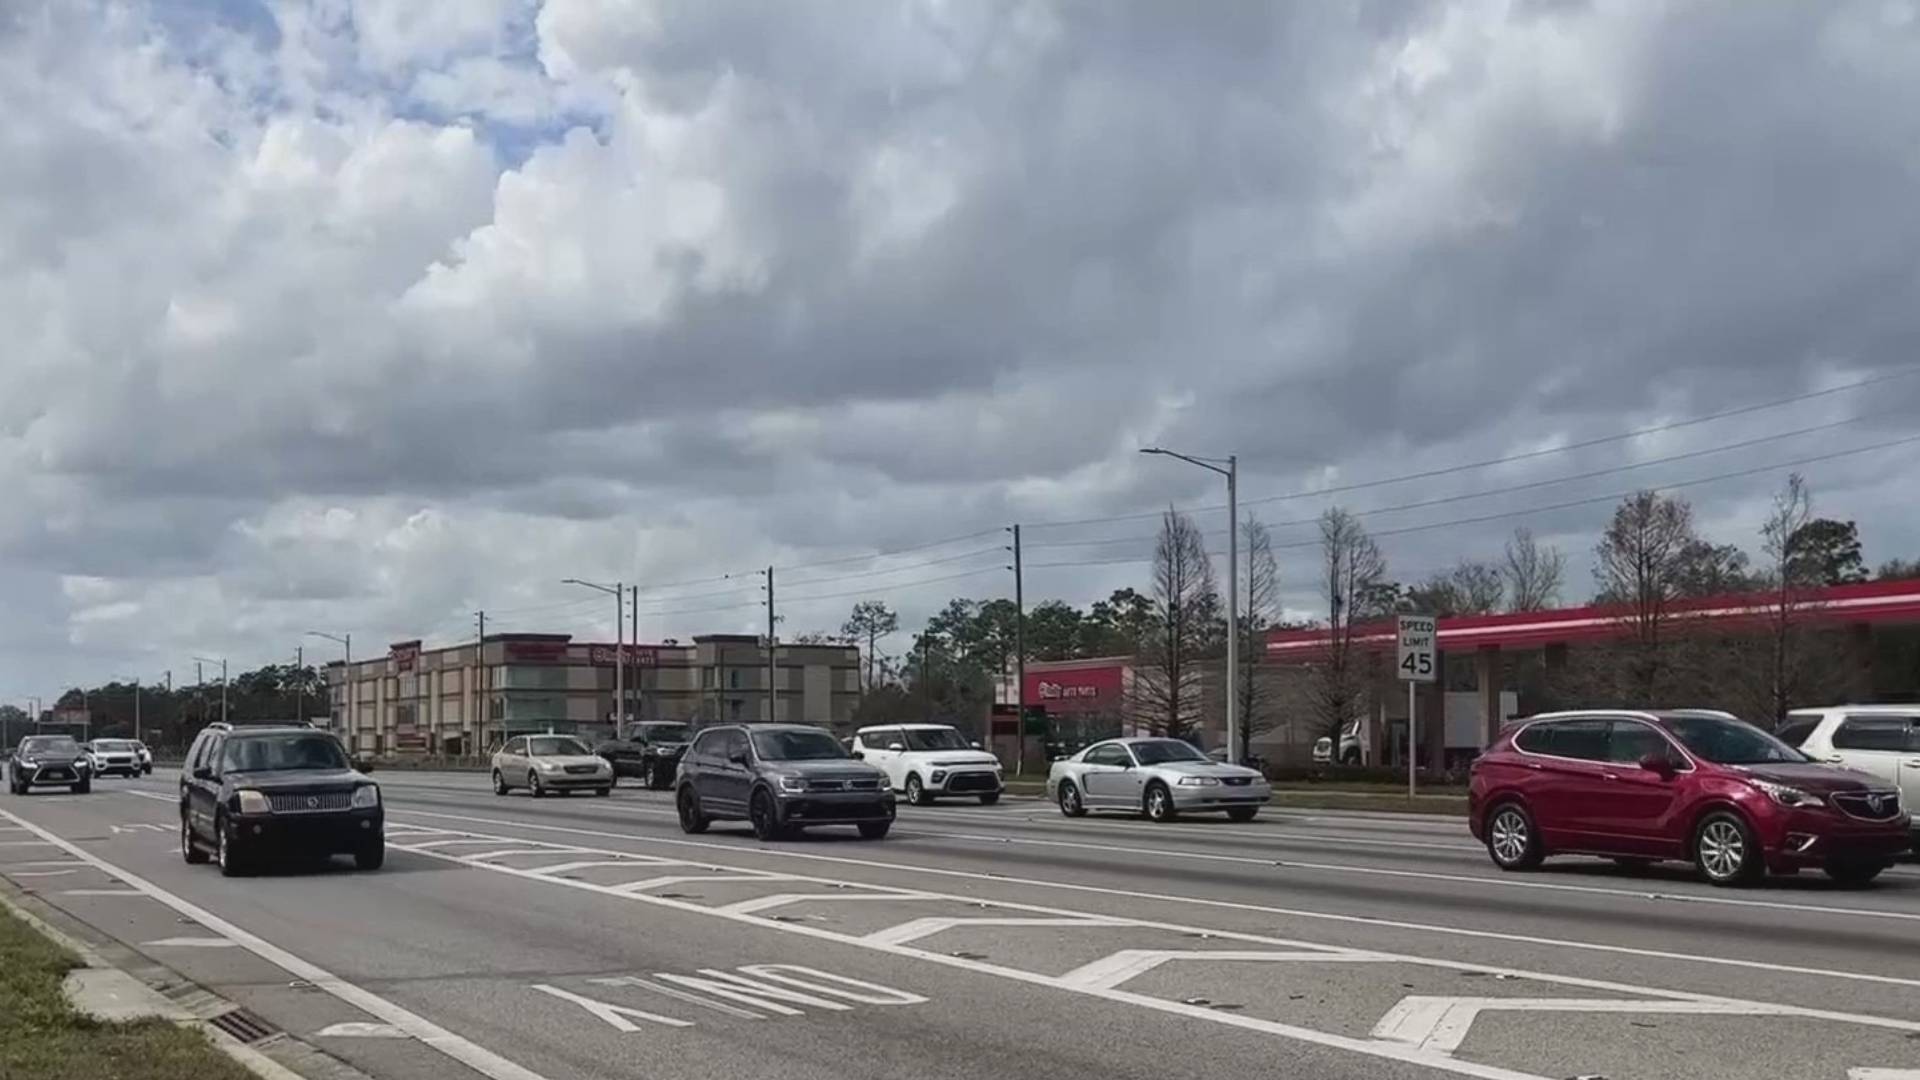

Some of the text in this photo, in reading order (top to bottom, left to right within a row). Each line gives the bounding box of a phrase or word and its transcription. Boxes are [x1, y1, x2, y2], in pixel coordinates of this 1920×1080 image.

[1400, 621, 1433, 632] SPEED
[1403, 637, 1429, 647] LIMIT
[1401, 652, 1432, 674] 45
[531, 964, 931, 1032] ONLY
